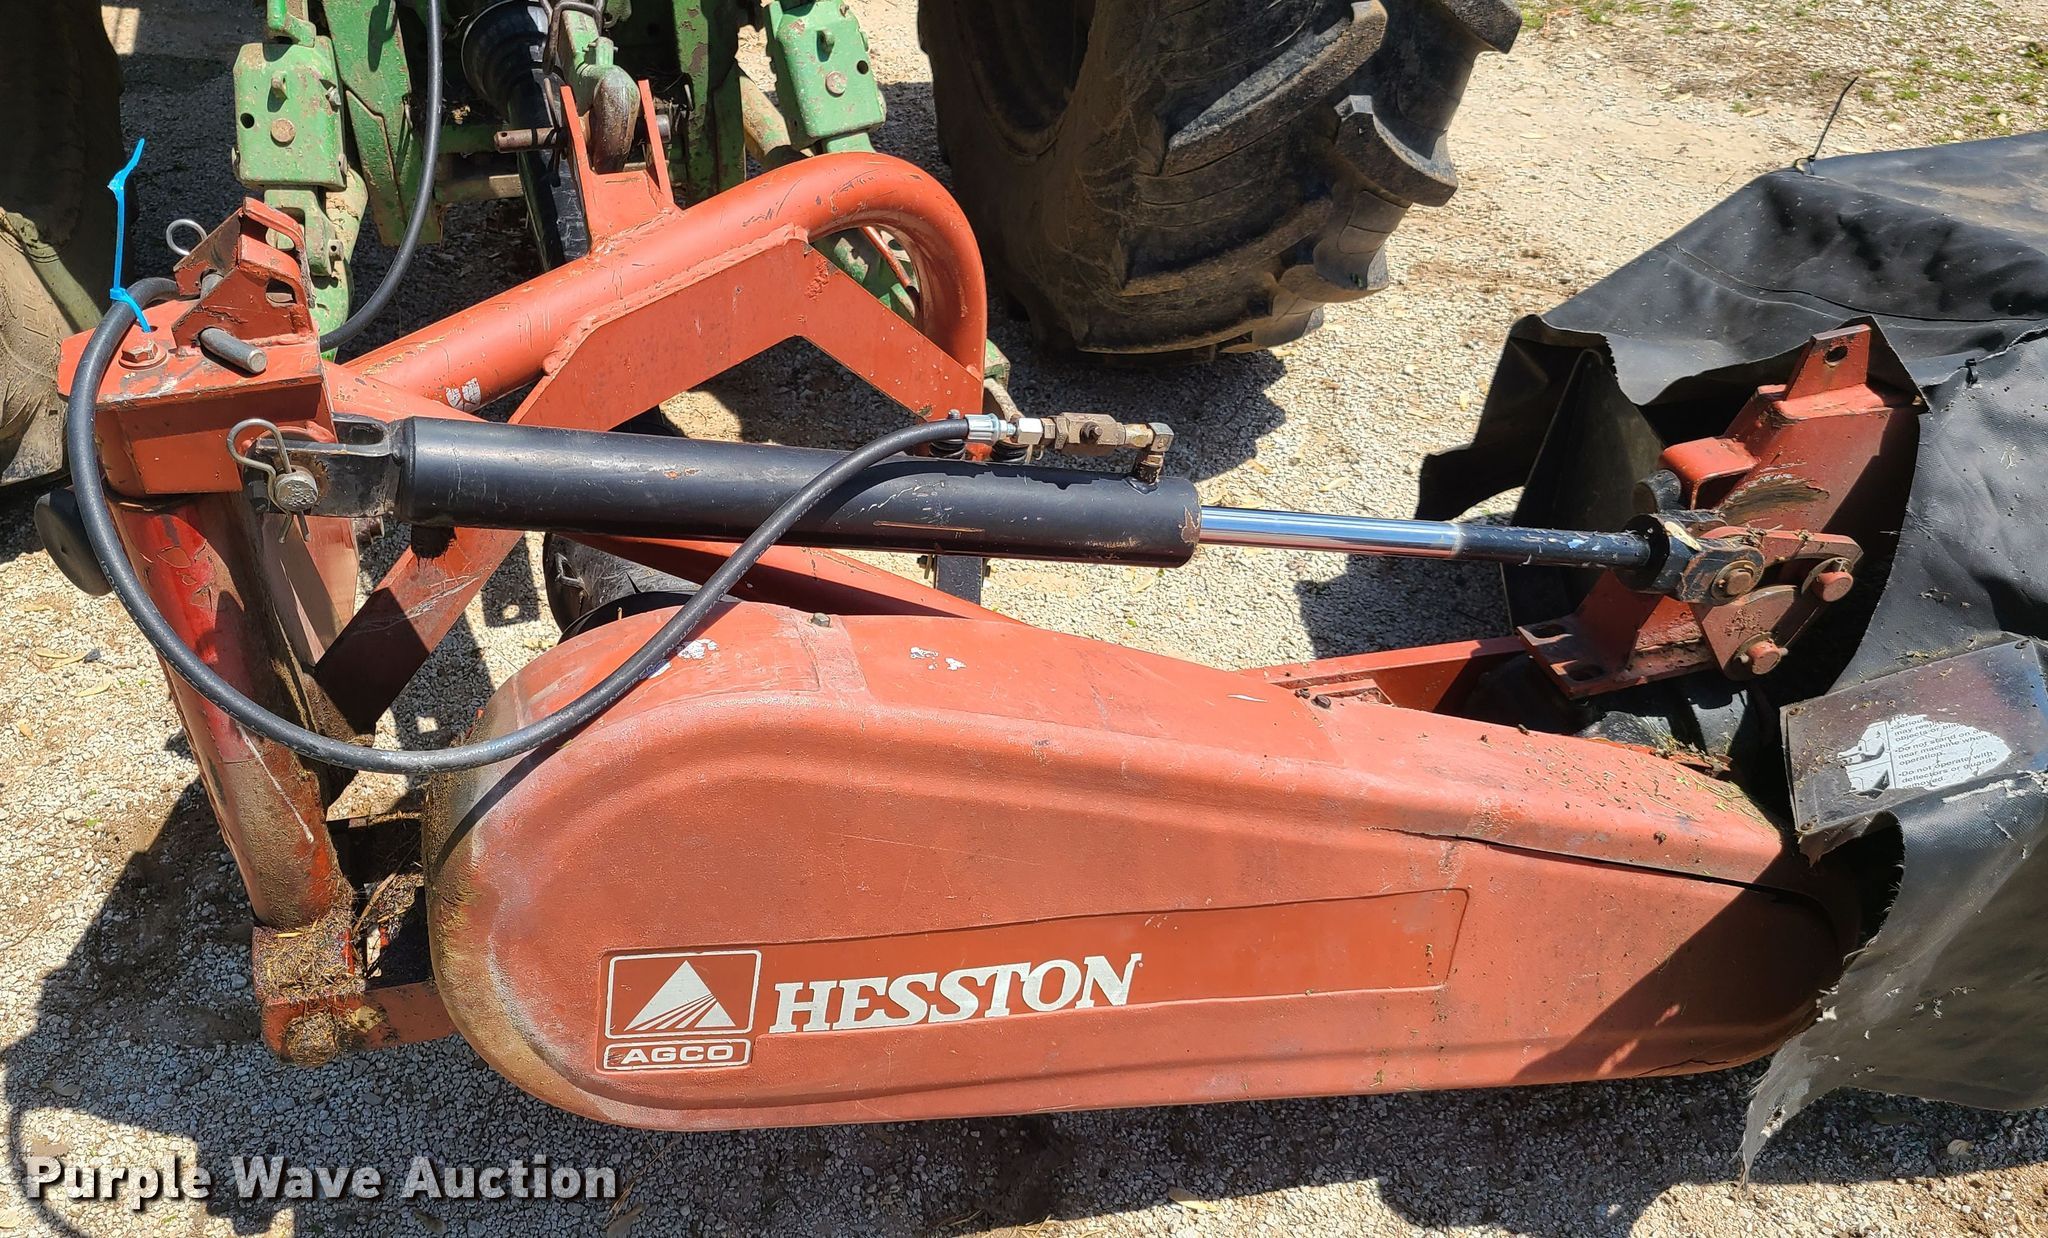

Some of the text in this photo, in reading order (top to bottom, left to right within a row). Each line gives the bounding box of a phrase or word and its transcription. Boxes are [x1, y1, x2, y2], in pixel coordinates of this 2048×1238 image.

[1895, 731, 1928, 742] objects
[1898, 733, 1988, 760] near machine when
[1934, 756, 1970, 770] operate
[1901, 768, 1949, 784] deflectors
[767, 952, 1145, 1034] HESSTON
[620, 1043, 735, 1066] AGCO
